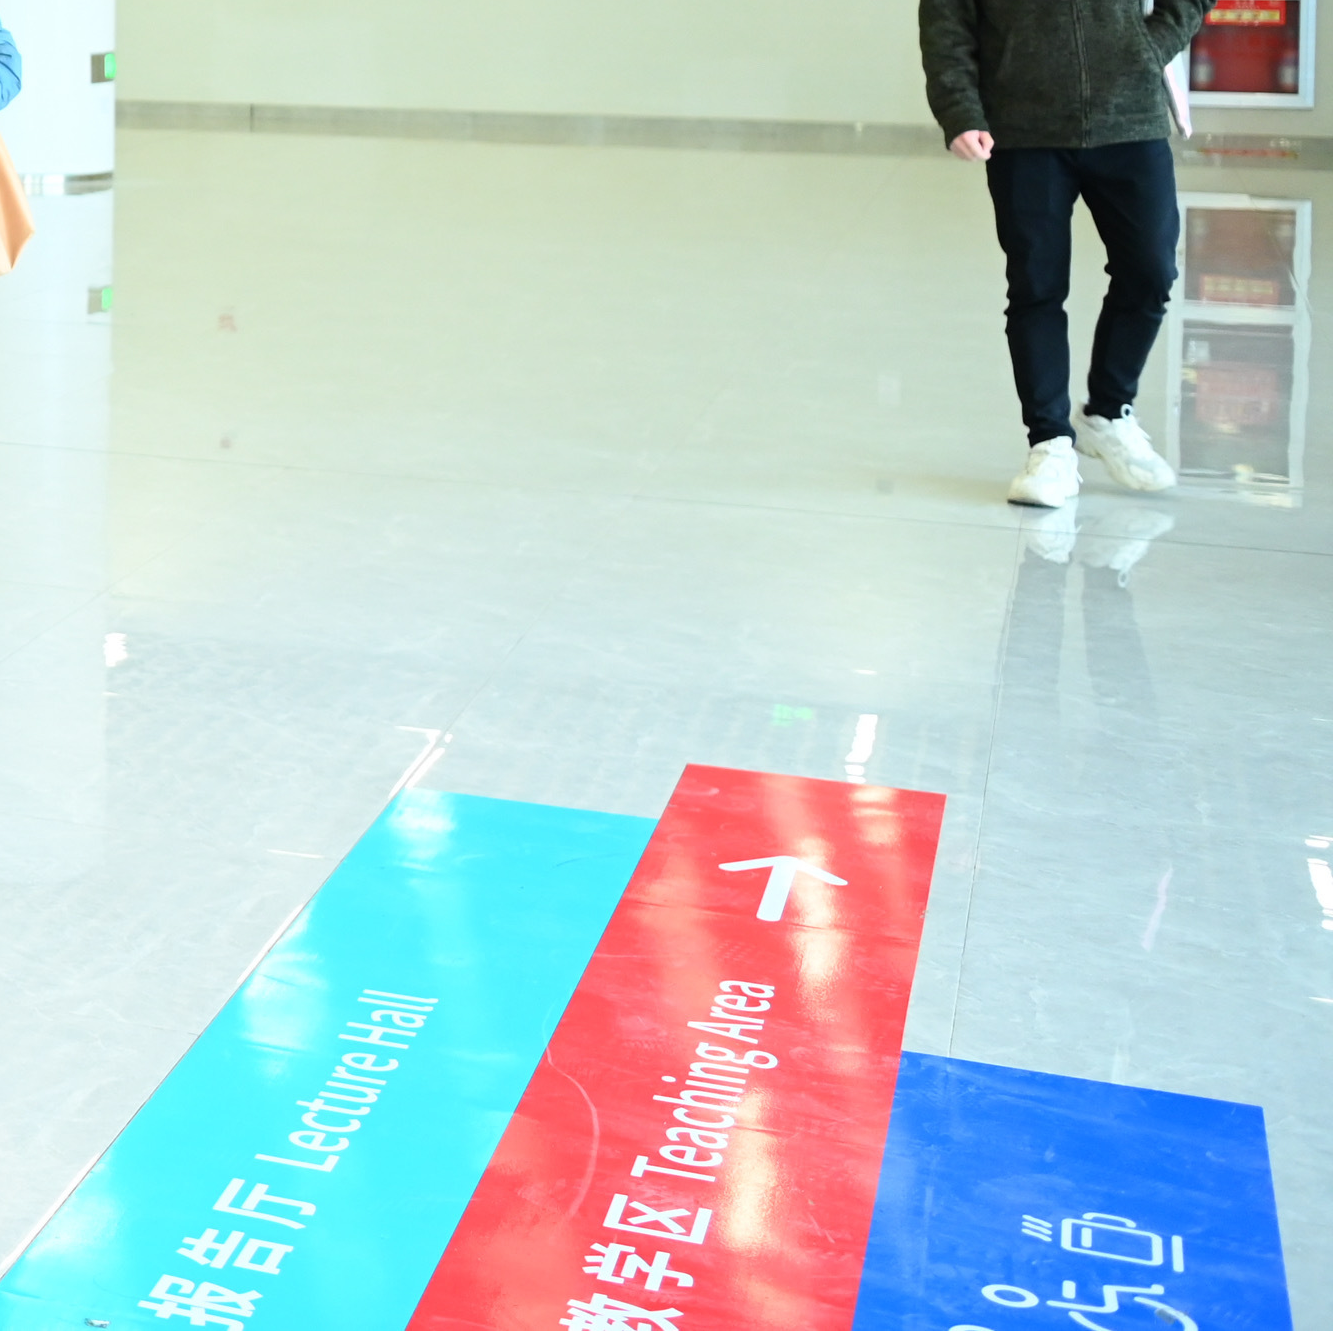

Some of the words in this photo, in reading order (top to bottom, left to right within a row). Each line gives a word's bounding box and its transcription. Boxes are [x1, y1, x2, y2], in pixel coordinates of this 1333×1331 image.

[254, 1052, 399, 1172] Lecture
[338, 989, 439, 1049] Hall
[687, 980, 775, 1044] Area
[630, 1042, 778, 1182] Teaching
[137, 1177, 317, 1331] 报告厅
[559, 1193, 713, 1331] 教学区
